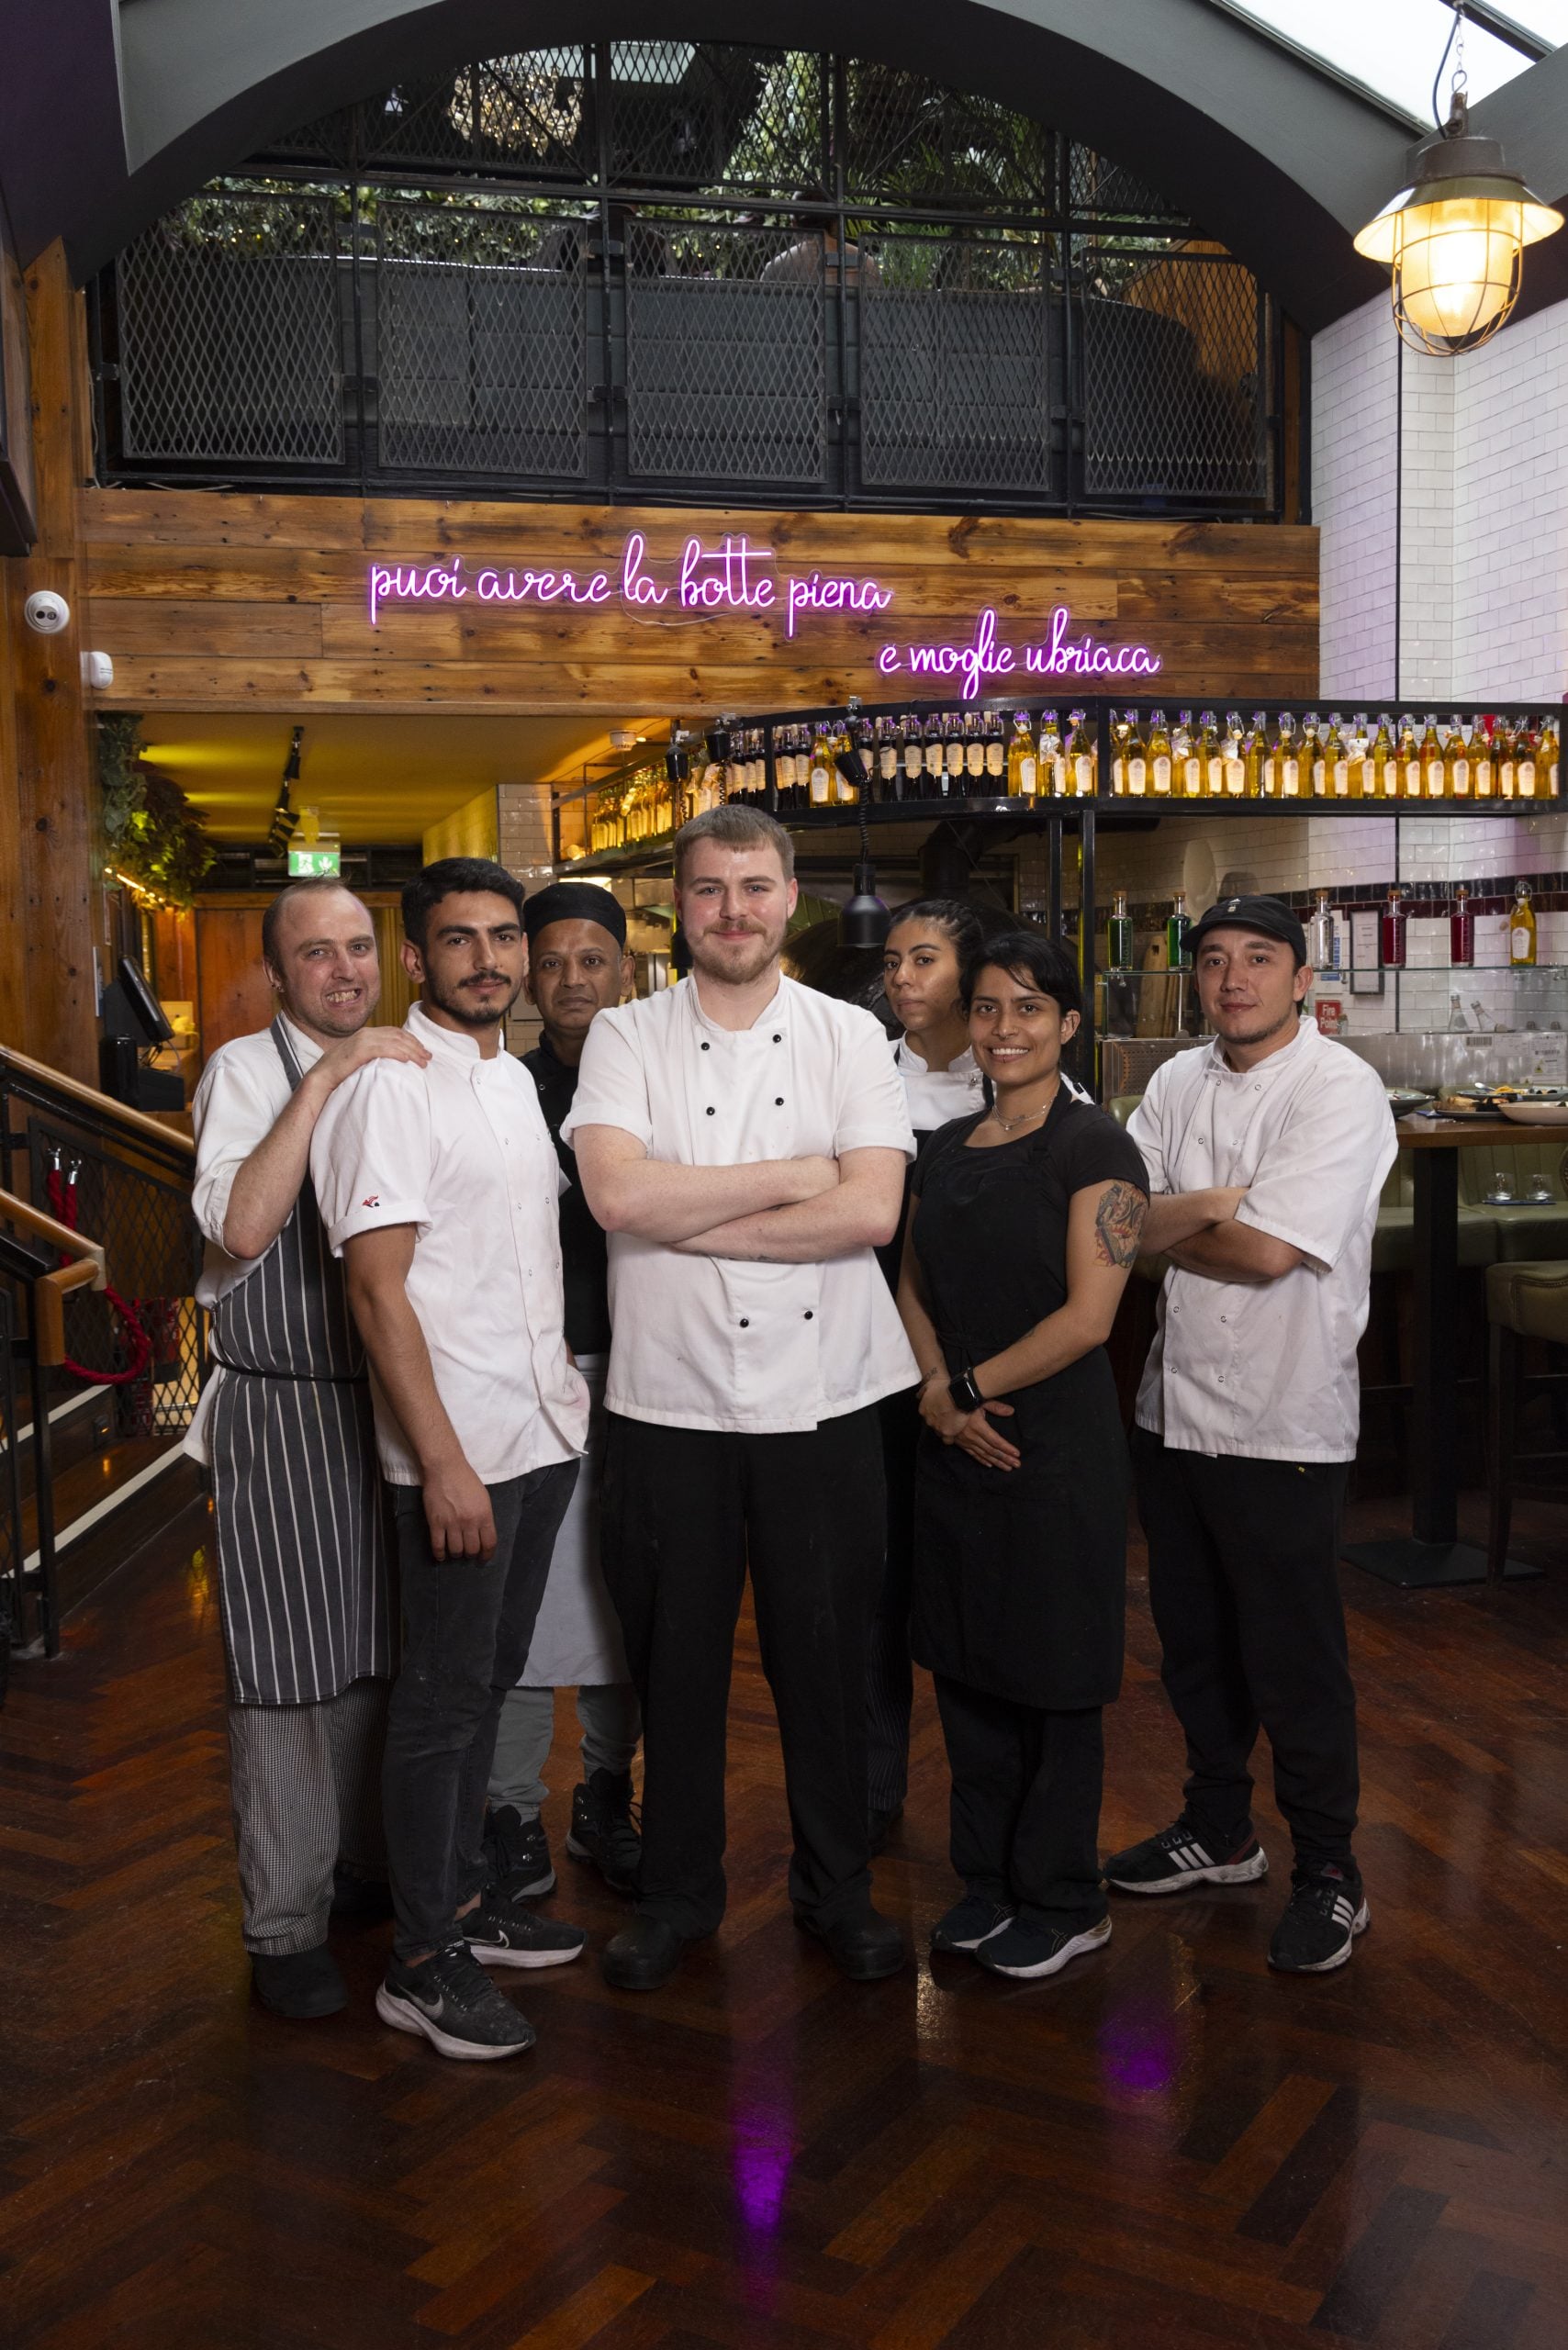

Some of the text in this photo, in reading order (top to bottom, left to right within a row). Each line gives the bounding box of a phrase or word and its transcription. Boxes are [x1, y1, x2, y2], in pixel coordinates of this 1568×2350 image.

[370, 533, 892, 638] puoi avere la botte piena
[879, 607, 1161, 700] e moglie ubriaca
[1322, 1004, 1336, 1016] Fire
